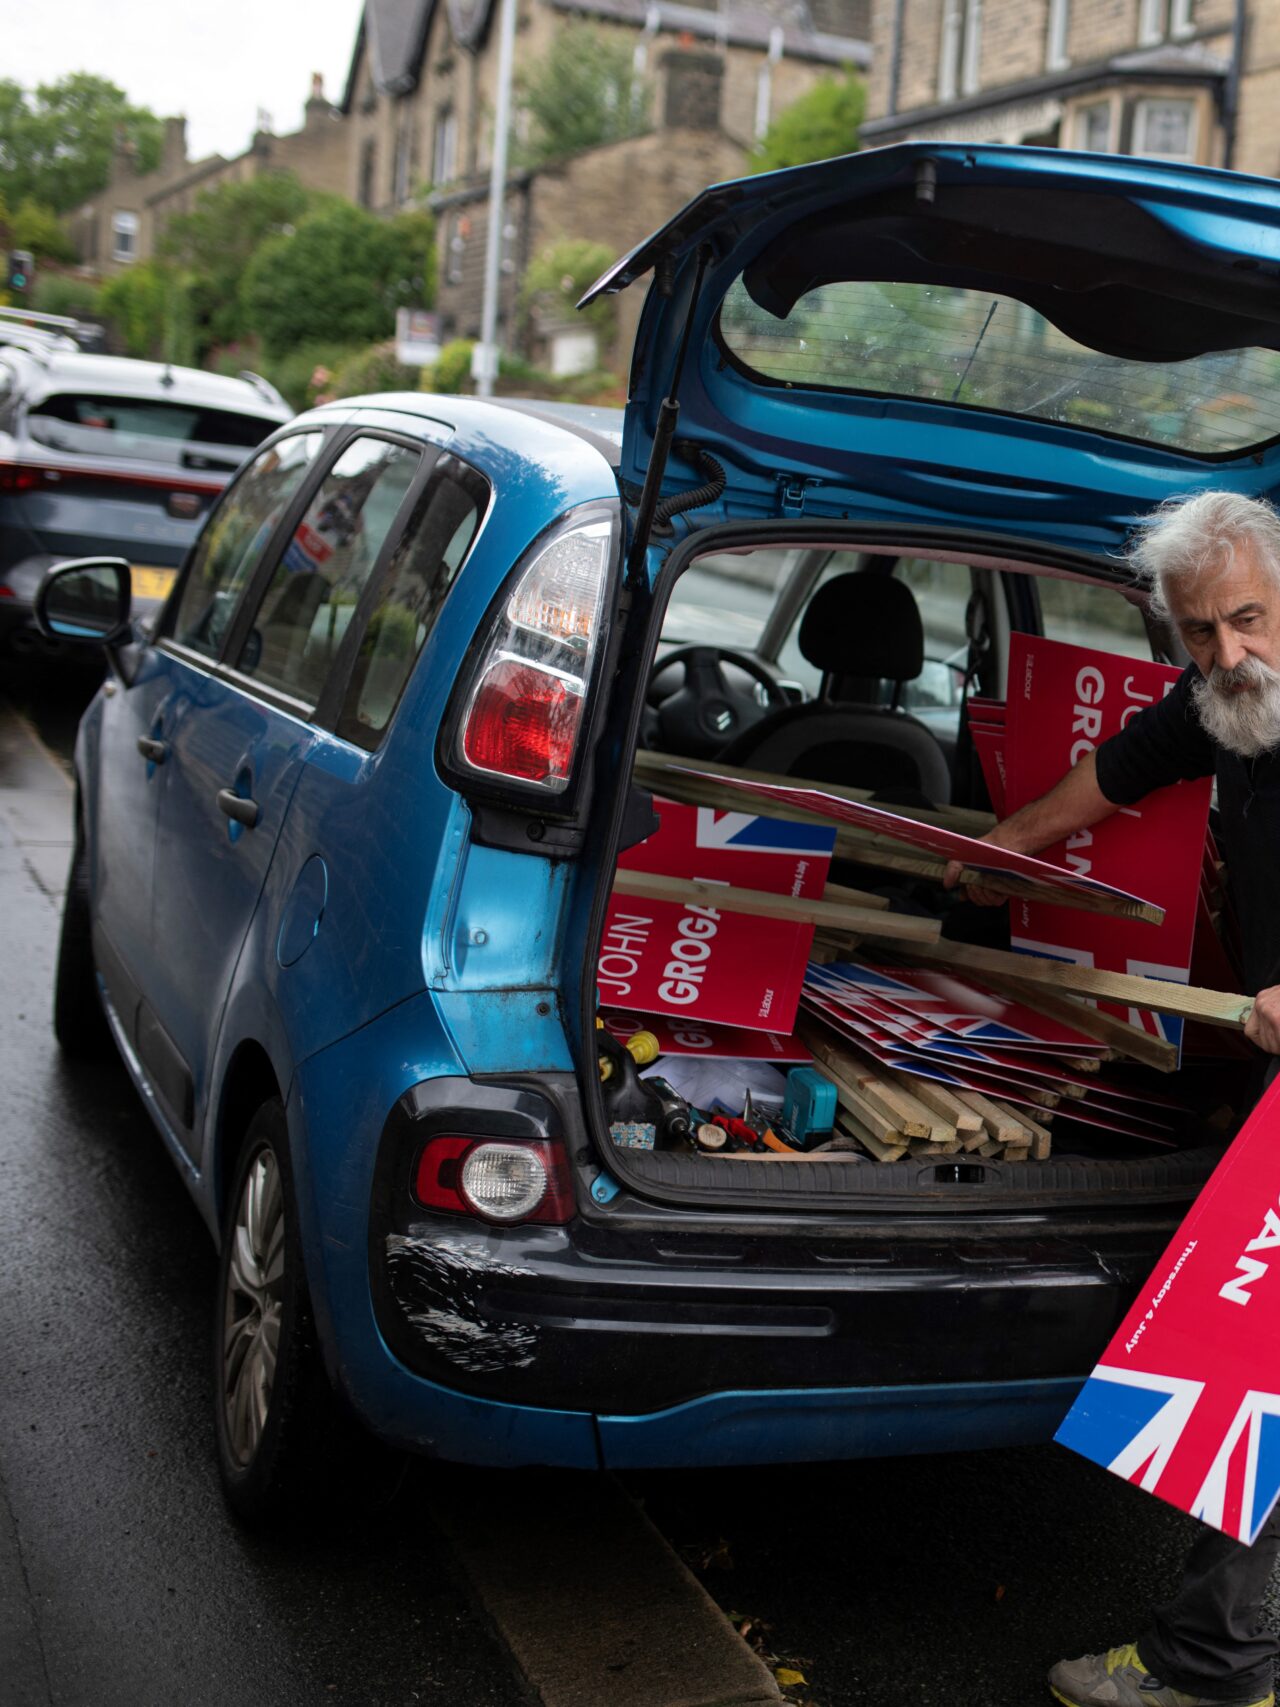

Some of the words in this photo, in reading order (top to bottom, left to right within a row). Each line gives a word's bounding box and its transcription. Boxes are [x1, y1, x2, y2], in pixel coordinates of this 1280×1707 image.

[596, 913, 654, 995] JOHN
[1151, 1240, 1198, 1309] Thursday
[1125, 1321, 1147, 1354] July
[1145, 1309, 1154, 1320] 4
